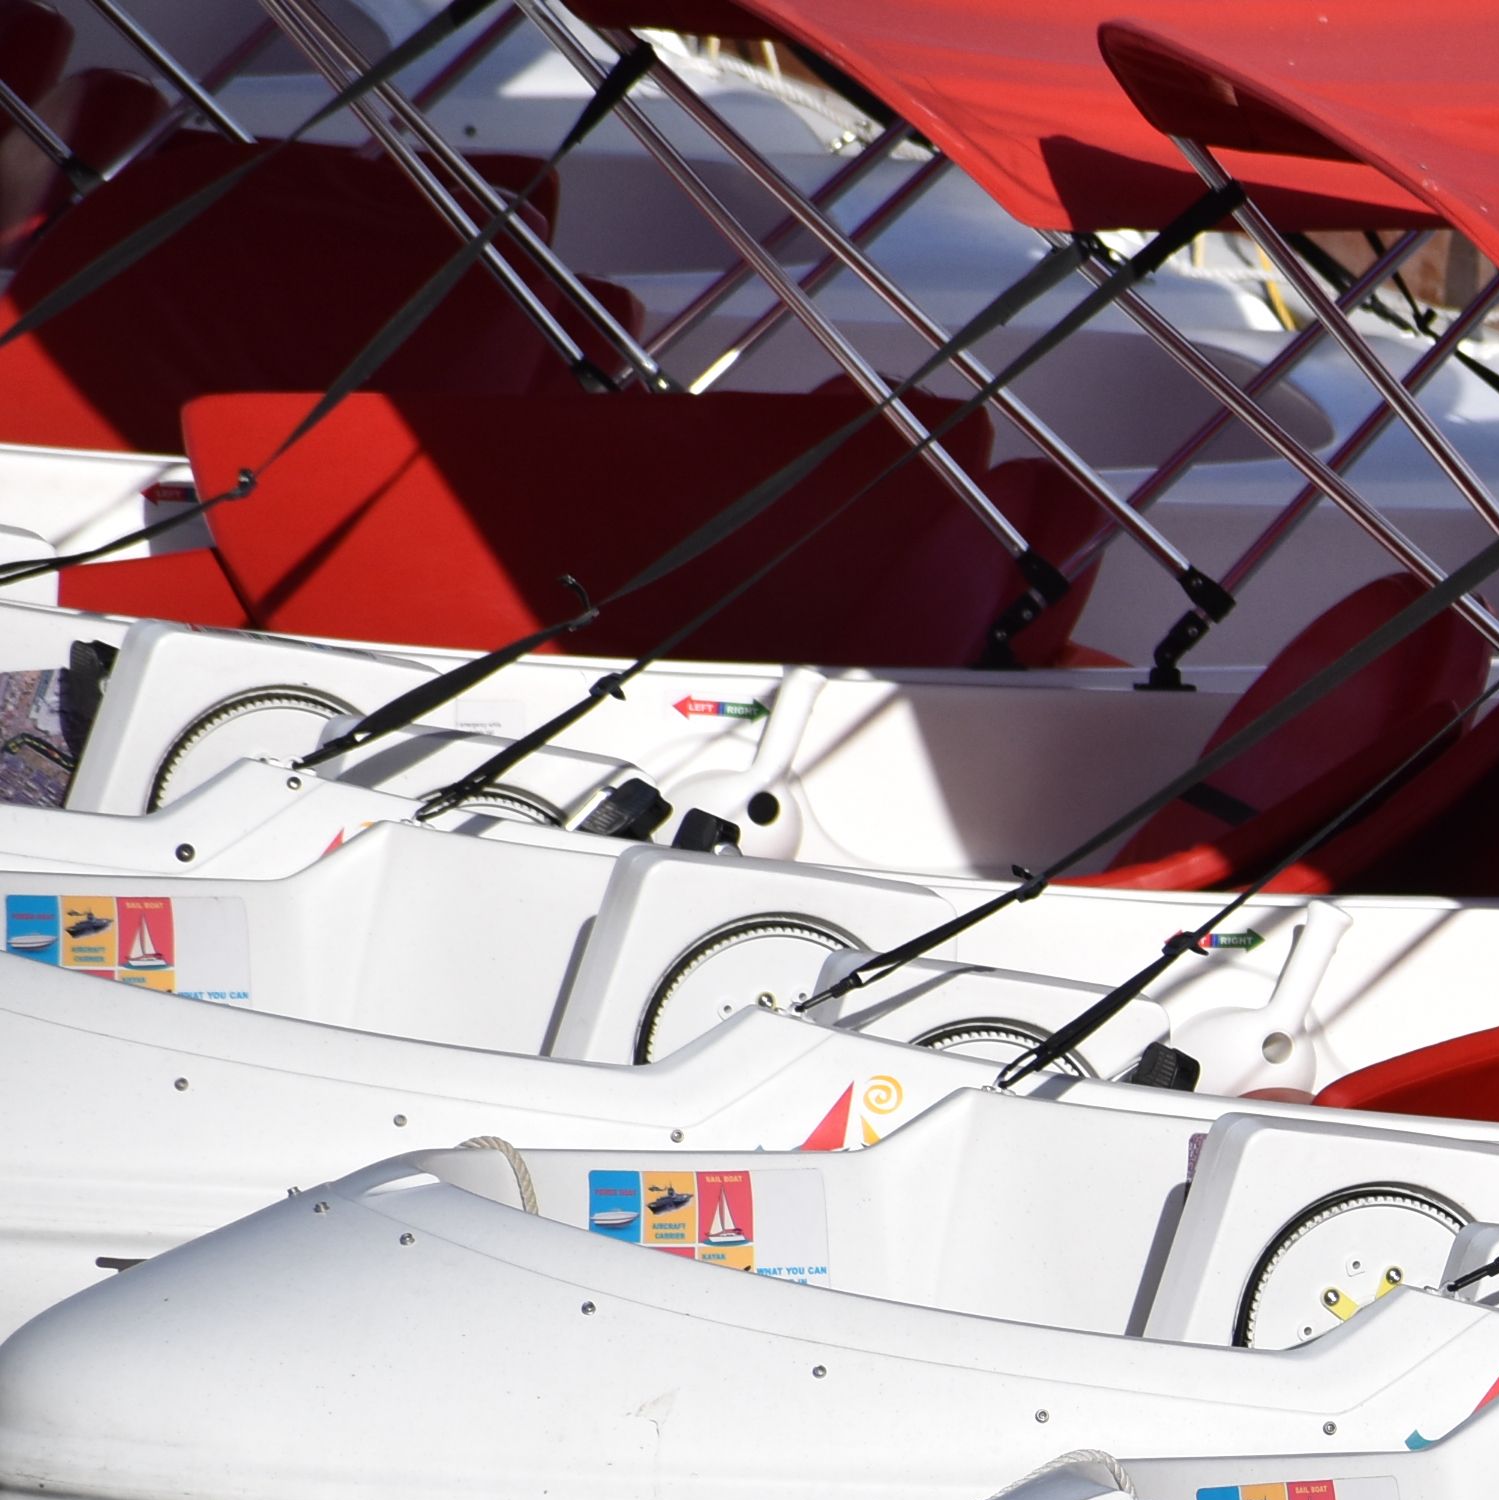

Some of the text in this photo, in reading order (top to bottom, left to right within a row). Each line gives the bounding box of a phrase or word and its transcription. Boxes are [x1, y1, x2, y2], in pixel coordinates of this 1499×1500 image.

[687, 702, 759, 716] LEFT RIGHT
[1219, 936, 1254, 945] RIGHT
[207, 991, 226, 999] YOU
[229, 991, 249, 999] CAN
[757, 1266, 827, 1276] WHAT YOU CAN
